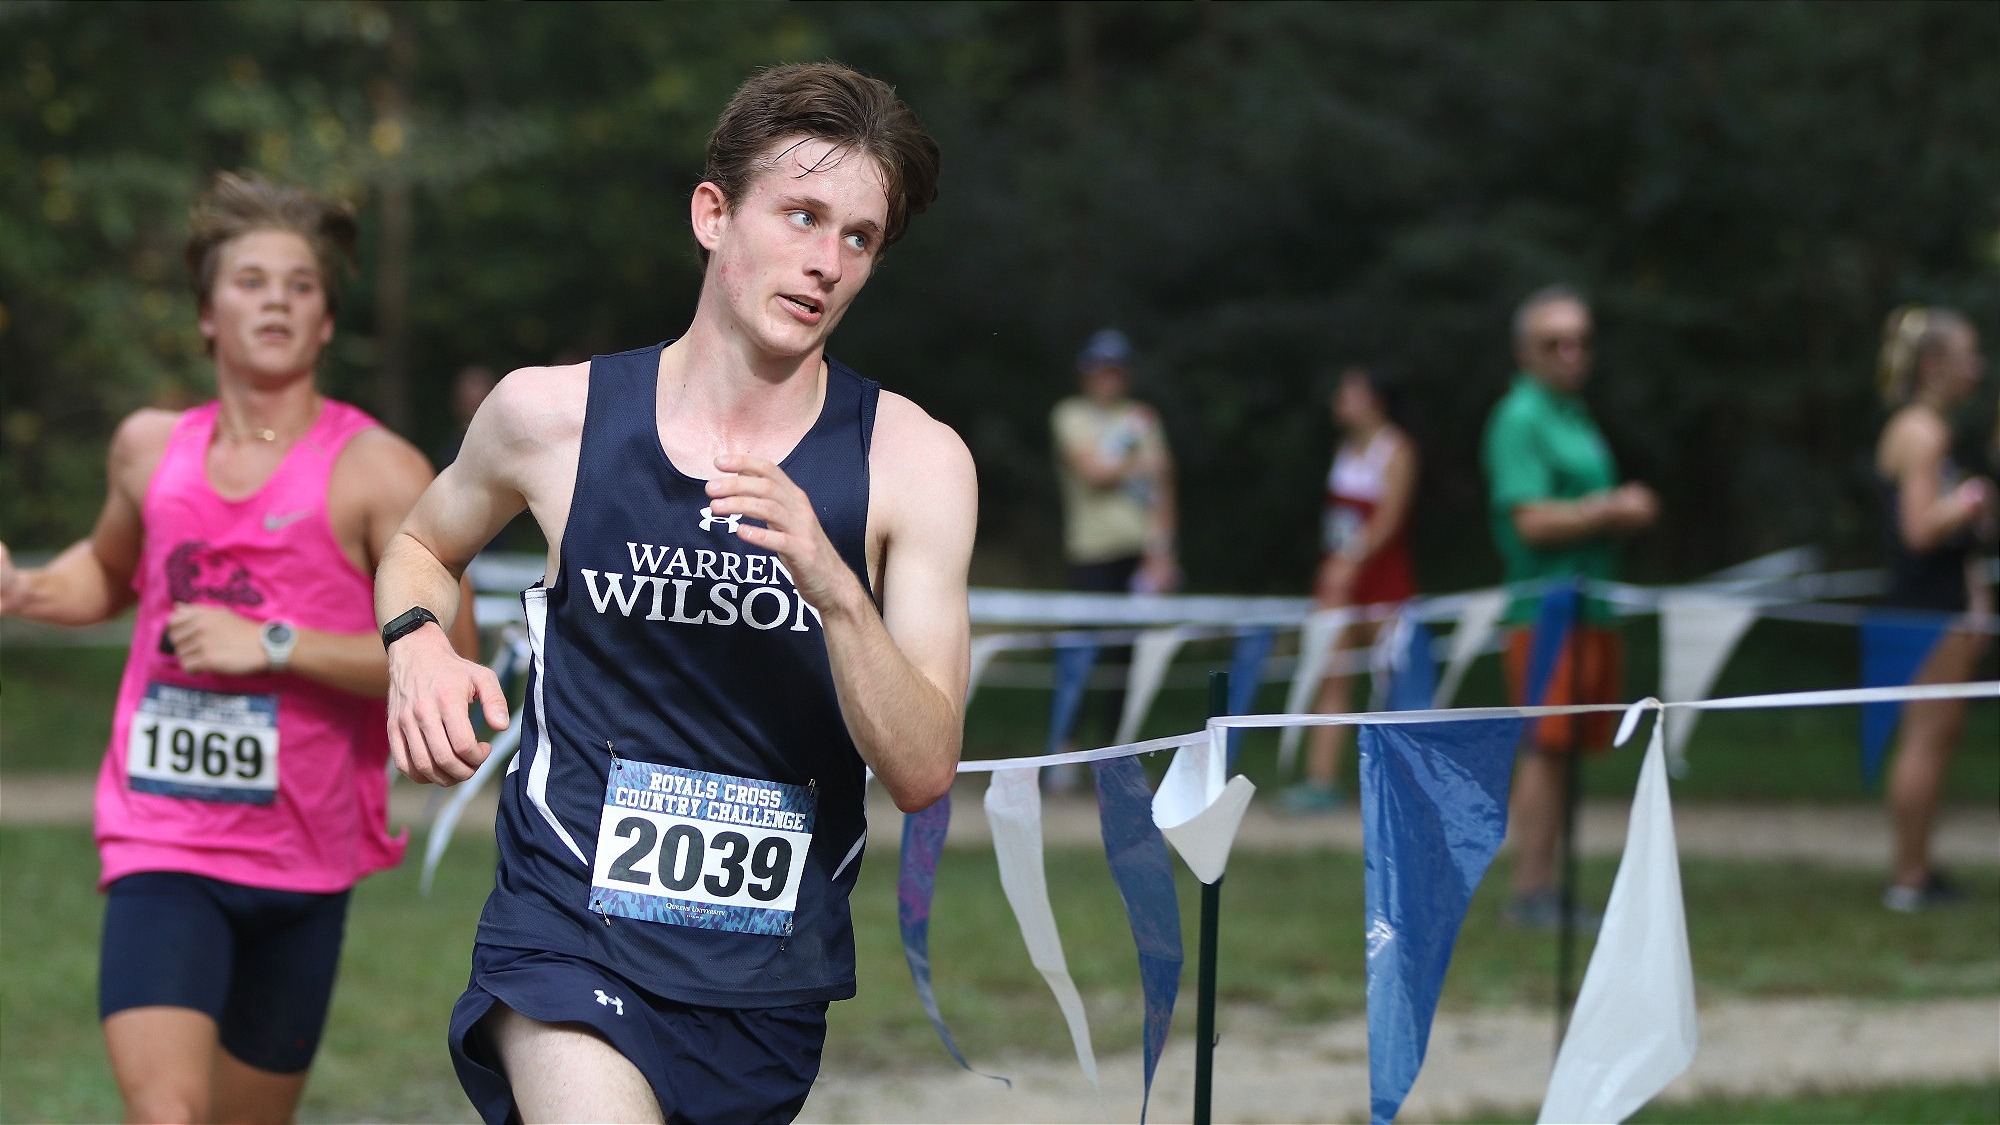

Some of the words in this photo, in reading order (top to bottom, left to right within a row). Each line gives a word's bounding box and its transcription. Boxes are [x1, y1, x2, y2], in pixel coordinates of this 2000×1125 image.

[144, 723, 264, 780] 1969
[615, 787, 701, 818] COUNTRY
[706, 802, 806, 831] CHALLENGE
[649, 772, 718, 800] ROYALS
[723, 784, 782, 809] CROSS
[607, 816, 794, 902] 2039
